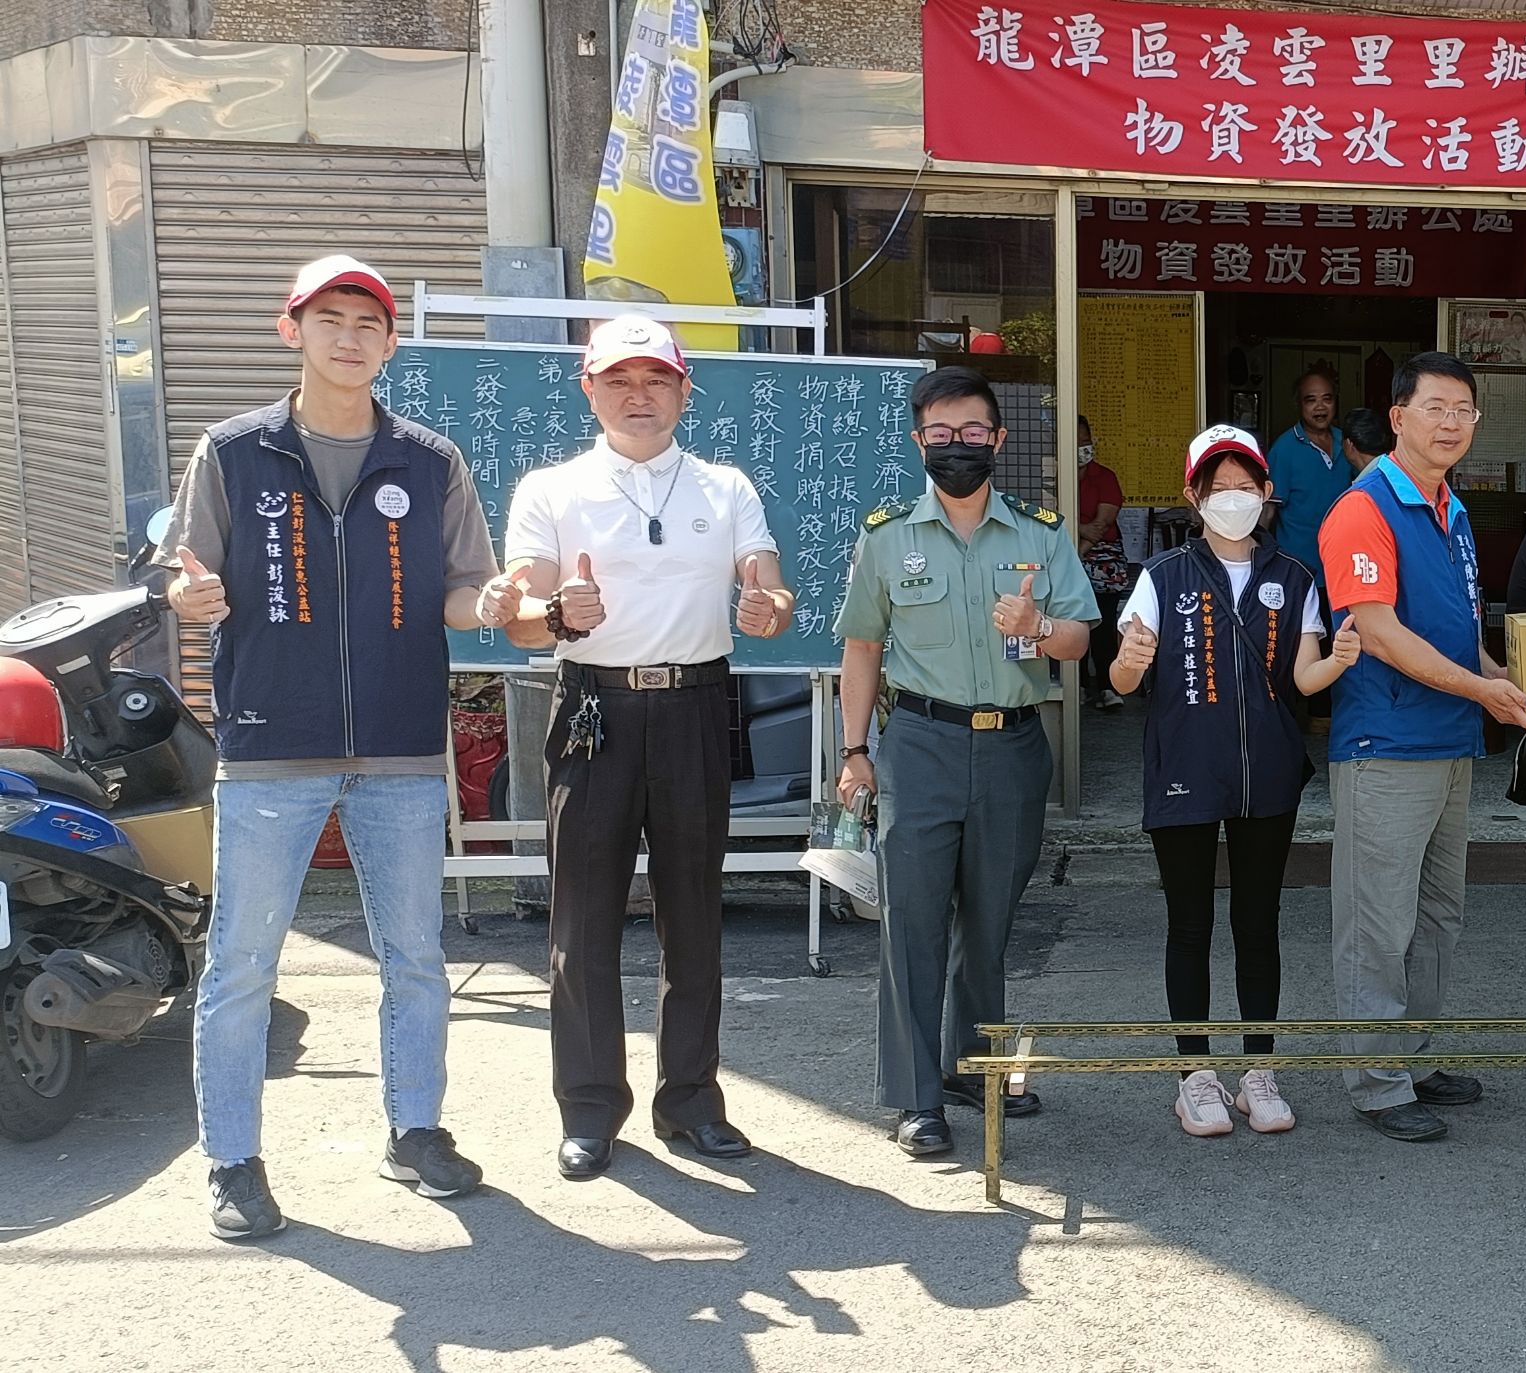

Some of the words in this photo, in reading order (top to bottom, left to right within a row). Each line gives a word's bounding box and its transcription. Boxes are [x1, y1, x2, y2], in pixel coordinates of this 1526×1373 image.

[1099, 238, 1416, 288] 物資發放活動
[435, 393, 461, 438] 上午
[792, 373, 831, 640] 物資捐贈發放活動
[1183, 617, 1200, 706] 主任莊子宜
